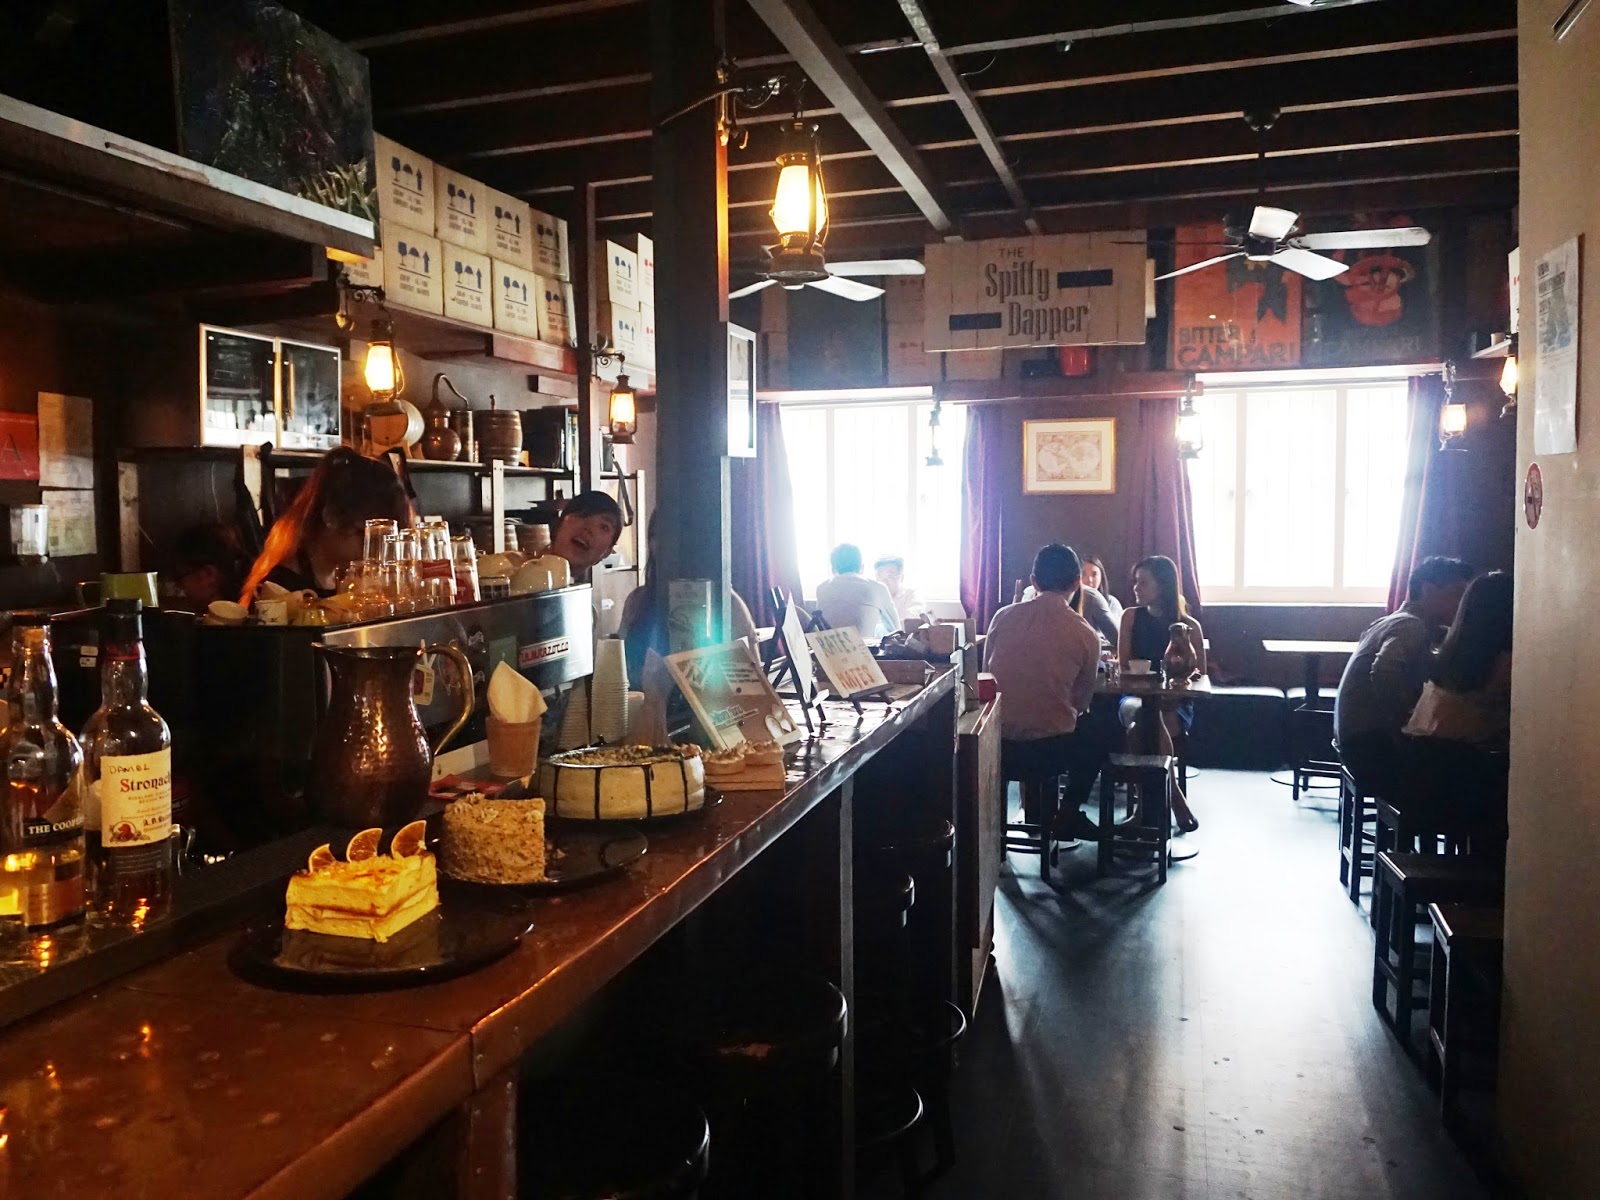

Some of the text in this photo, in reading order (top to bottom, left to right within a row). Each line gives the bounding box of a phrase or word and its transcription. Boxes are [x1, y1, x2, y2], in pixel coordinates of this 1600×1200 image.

[998, 247, 1025, 260] THE
[984, 259, 1050, 304] Spiffy
[1007, 301, 1089, 341] Dapper
[1178, 325, 1241, 345] BITTER
[1176, 340, 1295, 367] CAMPARI
[109, 763, 151, 775] DANIEL
[28, 824, 51, 835] THE
